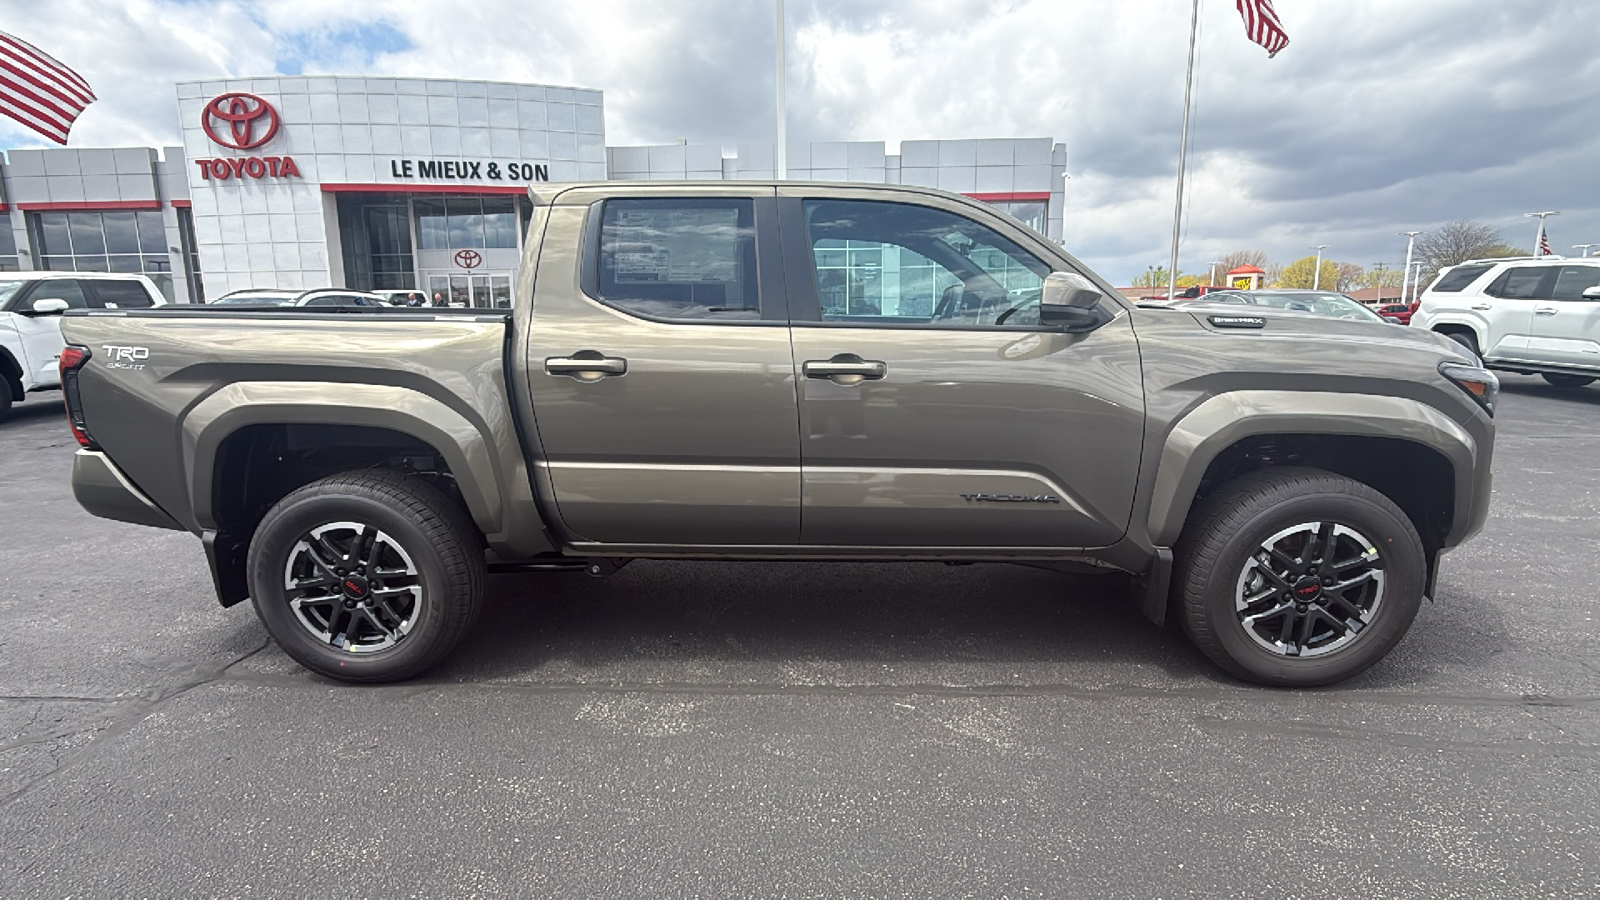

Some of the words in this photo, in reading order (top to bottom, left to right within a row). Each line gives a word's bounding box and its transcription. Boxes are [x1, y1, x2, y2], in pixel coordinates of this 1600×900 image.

[195, 156, 300, 180] TOYOTA
[391, 160, 413, 178] LE
[418, 160, 482, 179] MIEUX
[486, 162, 502, 180] &
[508, 162, 549, 182] SON
[102, 345, 149, 362] TRD
[960, 492, 1060, 504] TACOMA
